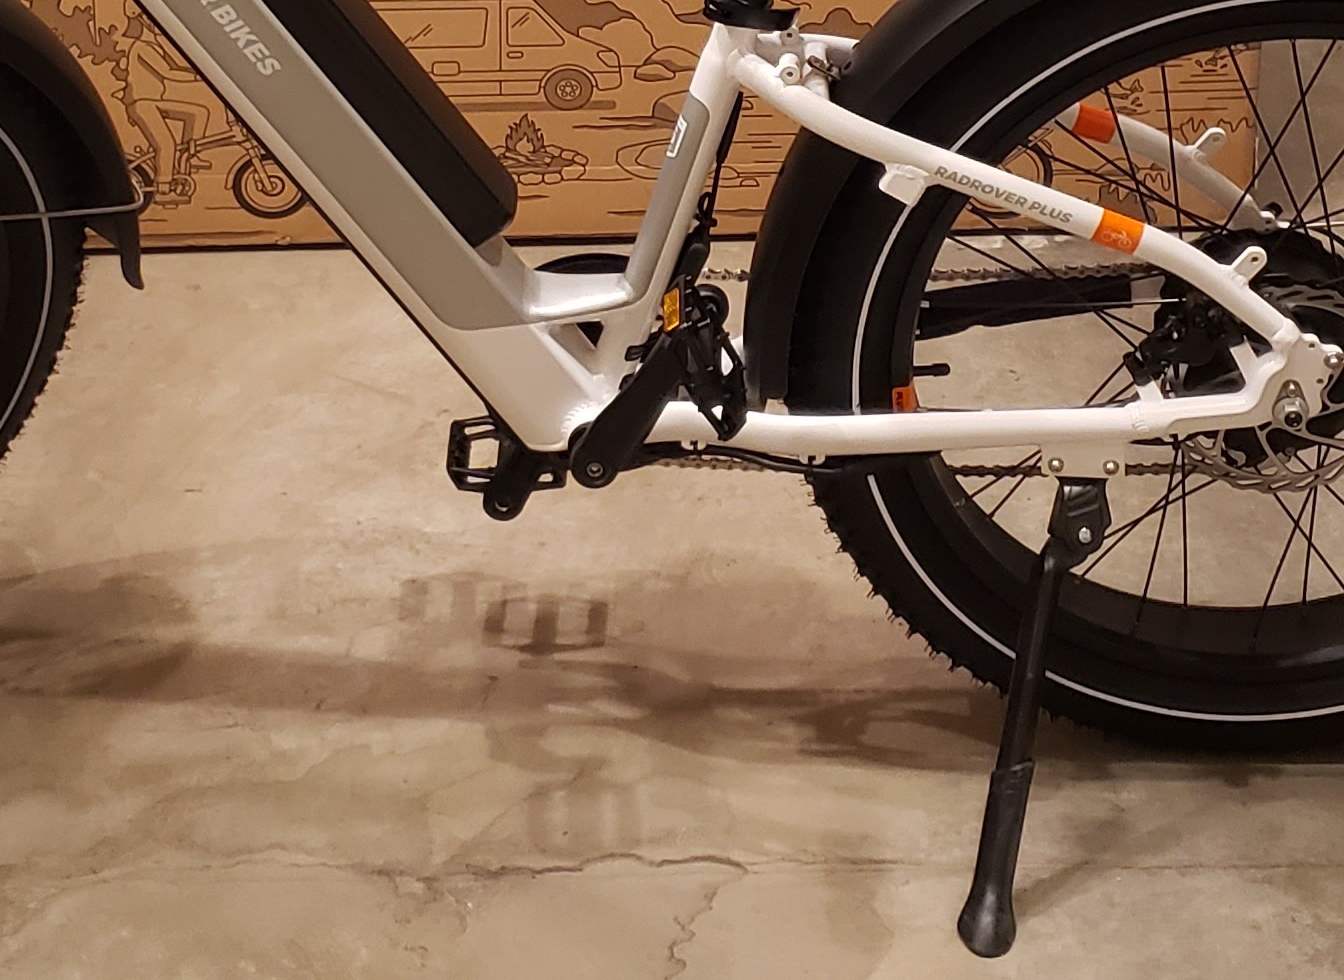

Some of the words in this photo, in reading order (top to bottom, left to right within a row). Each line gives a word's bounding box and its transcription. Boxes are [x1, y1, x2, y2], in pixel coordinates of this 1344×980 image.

[210, 4, 282, 76] BIKES
[934, 165, 1028, 208] RADROVER
[1028, 200, 1074, 223] PLUS
